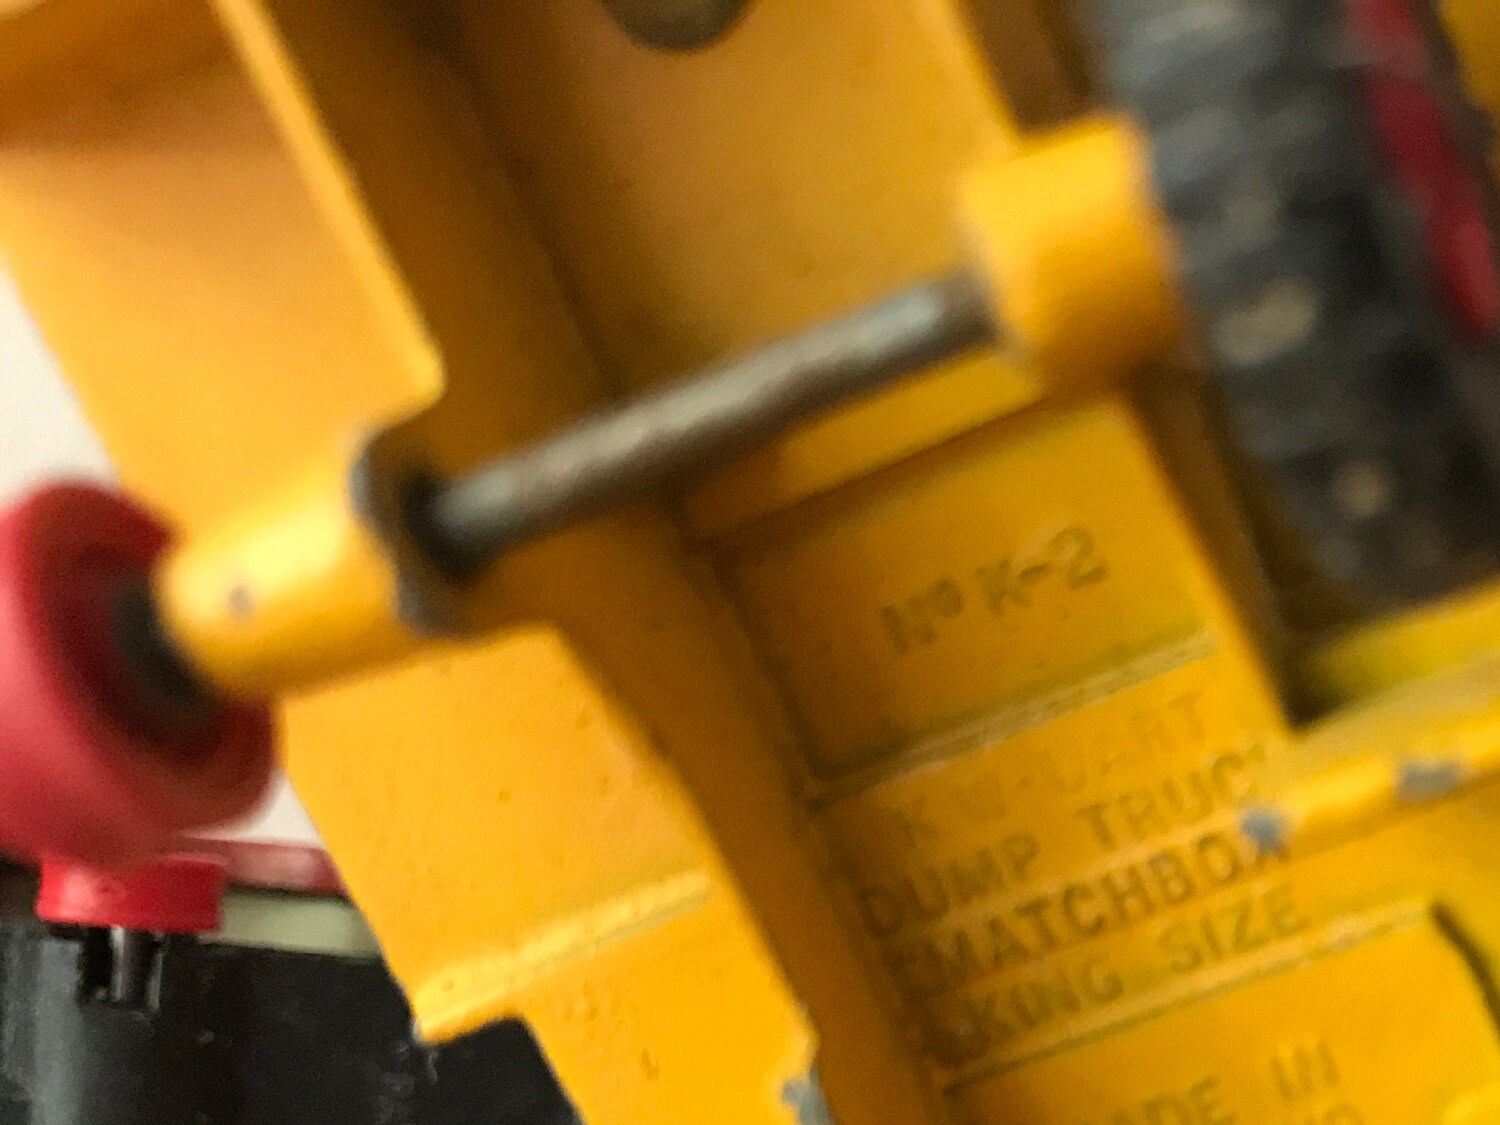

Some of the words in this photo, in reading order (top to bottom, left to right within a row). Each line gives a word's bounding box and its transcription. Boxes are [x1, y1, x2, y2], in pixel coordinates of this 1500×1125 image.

[857, 834, 1040, 940] DUMP
[1074, 740, 1270, 850] TRUC
[1158, 879, 1312, 975] SIZE
[1270, 1039, 1340, 1101] IN
